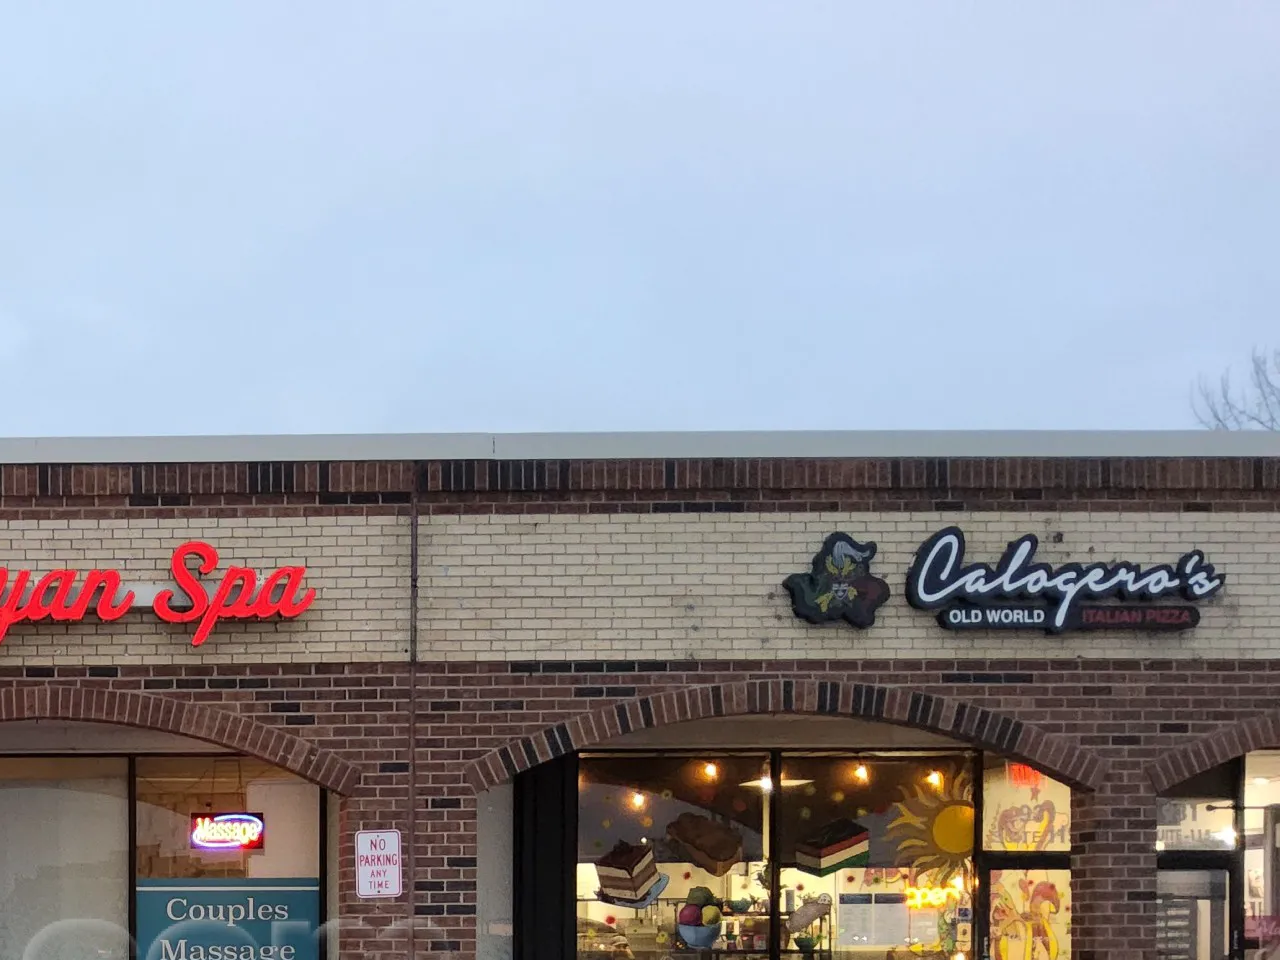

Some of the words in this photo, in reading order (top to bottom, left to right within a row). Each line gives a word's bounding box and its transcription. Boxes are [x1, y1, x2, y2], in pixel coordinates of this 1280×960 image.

[920, 533, 1224, 628] Calogero's
[152, 541, 318, 648] Spa
[949, 609, 982, 625] OLD
[985, 609, 1045, 625] WORLD
[1082, 609, 1141, 625] ITALIAN
[1145, 609, 1191, 625] PIZZA
[195, 816, 260, 846] Massage
[369, 838, 387, 851] NO
[359, 853, 398, 867] PARKING
[370, 869, 388, 879] ANY
[368, 880, 390, 890] TIME
[166, 897, 289, 927] Couples
